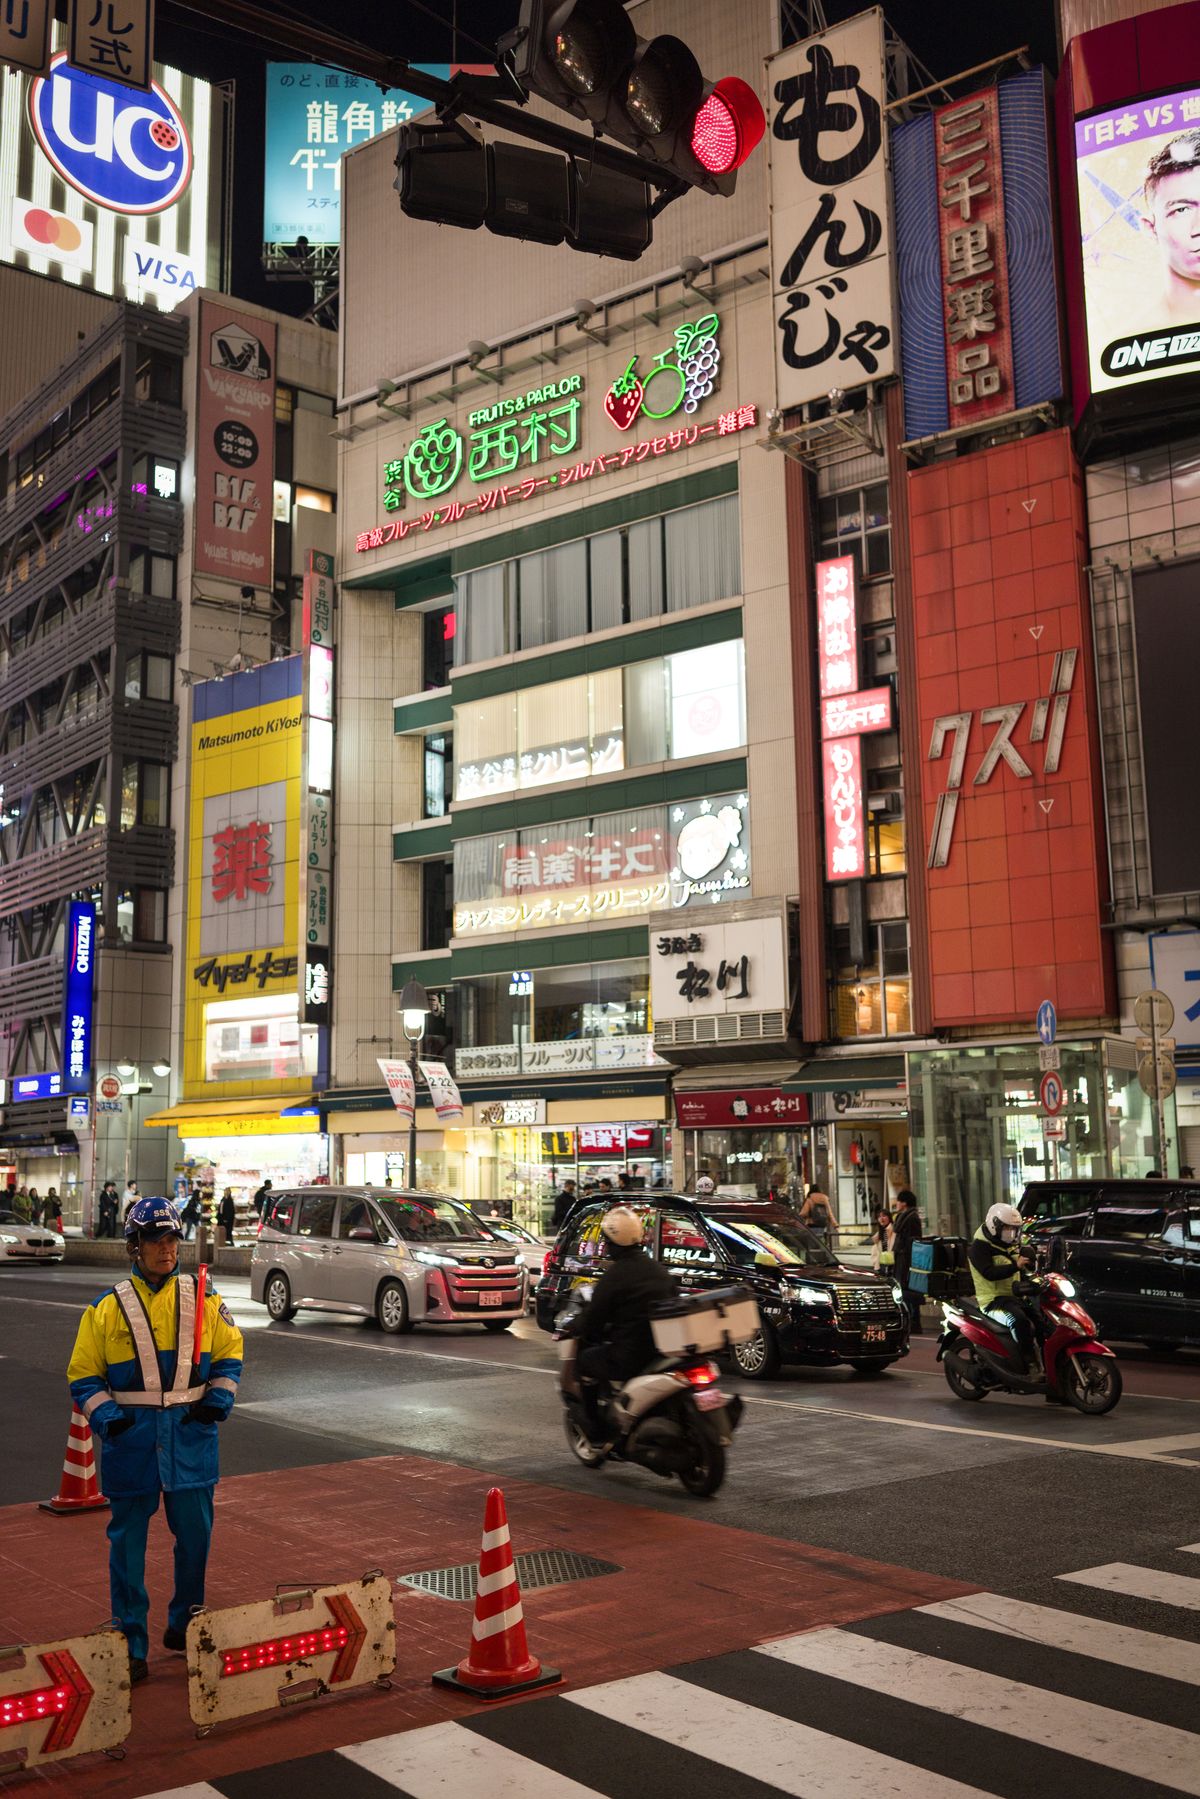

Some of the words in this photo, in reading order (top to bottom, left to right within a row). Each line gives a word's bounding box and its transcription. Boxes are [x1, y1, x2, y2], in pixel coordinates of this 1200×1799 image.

[1144, 103, 1175, 129] VS
[773, 44, 890, 374] もんじゃ
[134, 252, 197, 291] VISA
[940, 100, 1002, 405] 三千里薬品
[1110, 337, 1171, 370] ONE
[468, 397, 581, 482] 西村
[214, 472, 257, 503] B1F
[383, 460, 402, 512] 渋谷
[213, 501, 258, 533] B2F
[198, 723, 264, 750] Matsumoto
[265, 711, 302, 734] KiYos
[211, 820, 273, 903] 薬
[76, 915, 92, 974] MIZUHO
[656, 933, 703, 956] うなぎ
[676, 955, 749, 1003] 松川
